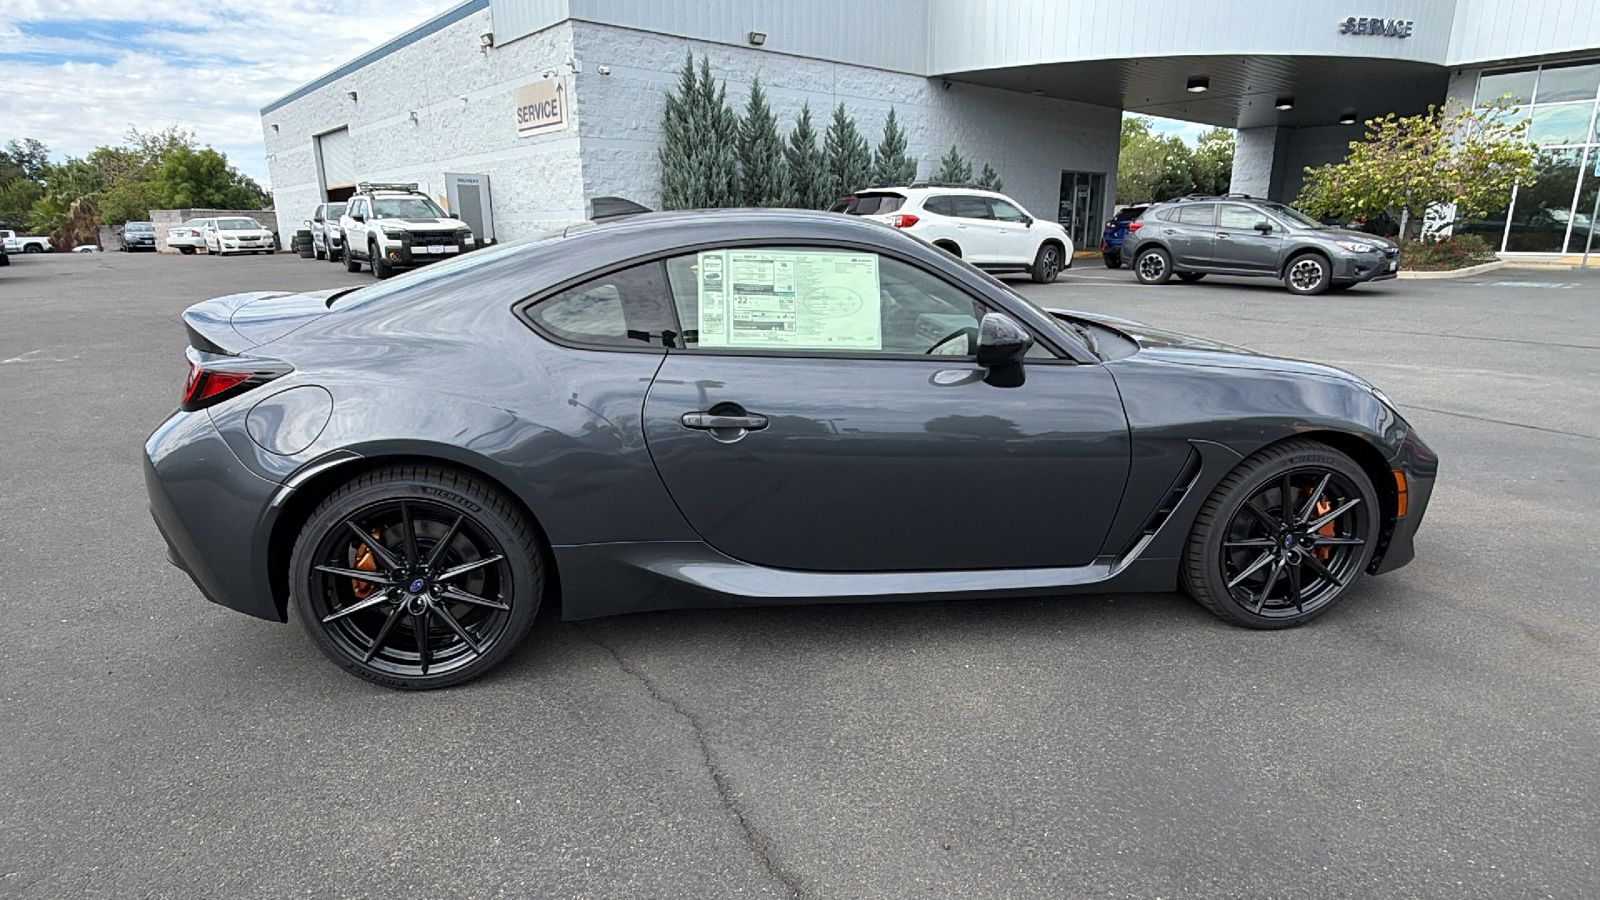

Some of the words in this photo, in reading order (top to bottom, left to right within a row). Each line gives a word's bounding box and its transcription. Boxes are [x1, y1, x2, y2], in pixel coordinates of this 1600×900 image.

[1342, 17, 1414, 37] SERVICE
[516, 98, 558, 124] SERVICE
[426, 487, 479, 512] MICHELIN
